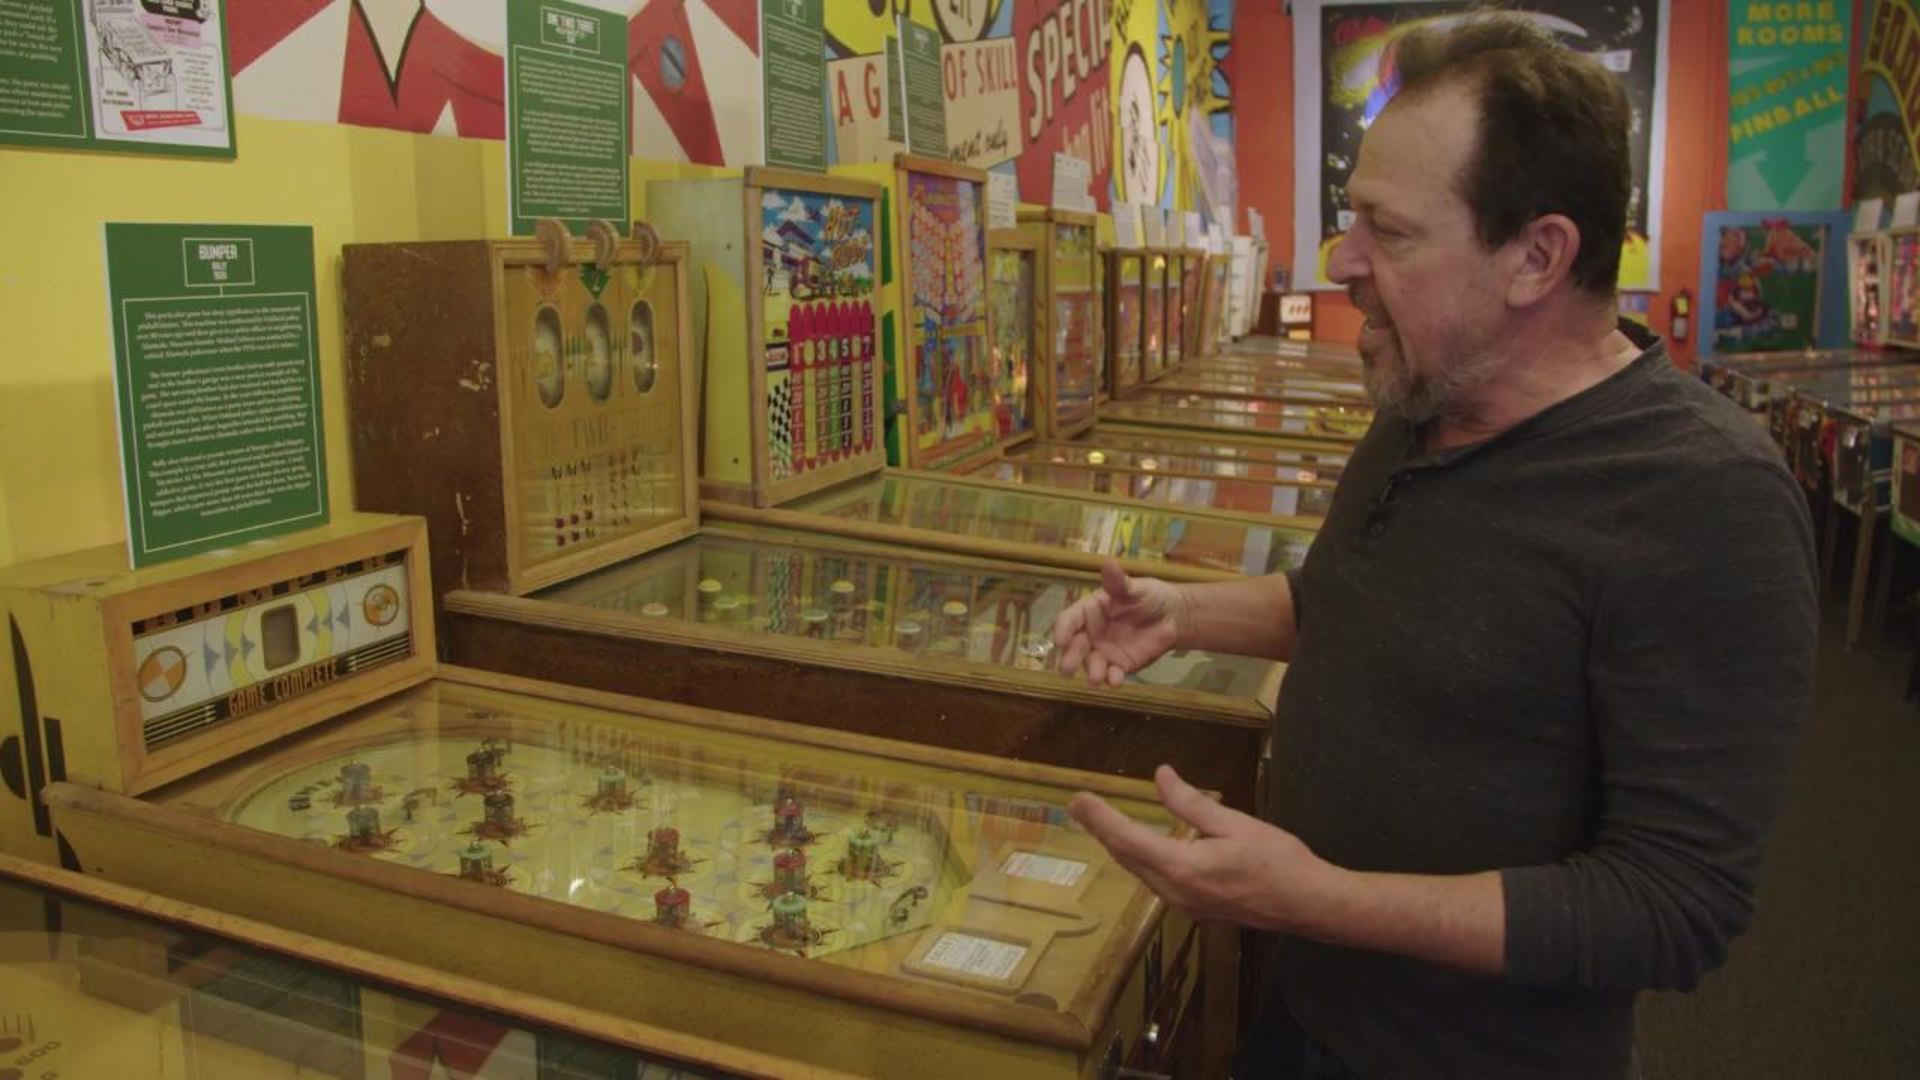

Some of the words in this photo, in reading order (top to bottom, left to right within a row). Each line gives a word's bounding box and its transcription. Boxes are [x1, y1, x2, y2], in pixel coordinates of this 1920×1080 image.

[1747, 2, 1835, 22] MORE
[1737, 23, 1843, 47] ROOMS
[838, 68, 855, 127] A
[943, 49, 967, 103] OF
[974, 44, 1017, 95] SKILL
[1730, 85, 1844, 144] PINBALL
[198, 244, 238, 261] BUMPER
[841, 336, 850, 359] 5
[229, 682, 266, 718] GAME
[273, 657, 338, 701] COMPLETE
